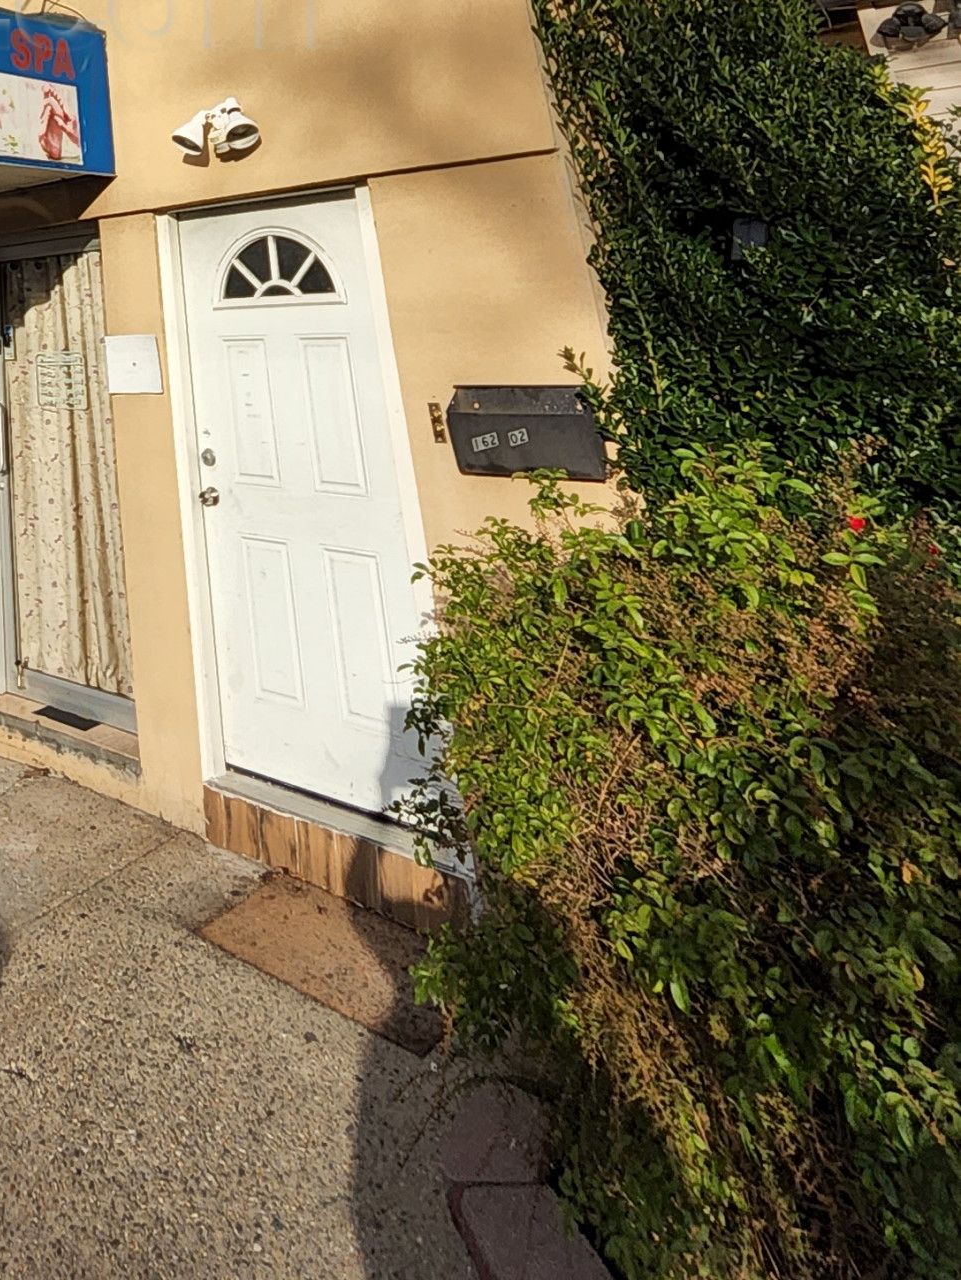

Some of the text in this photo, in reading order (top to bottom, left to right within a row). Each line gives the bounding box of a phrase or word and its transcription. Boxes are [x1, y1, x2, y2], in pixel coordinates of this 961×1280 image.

[9, 28, 76, 79] SPA
[474, 430, 526, 450] 162 02
